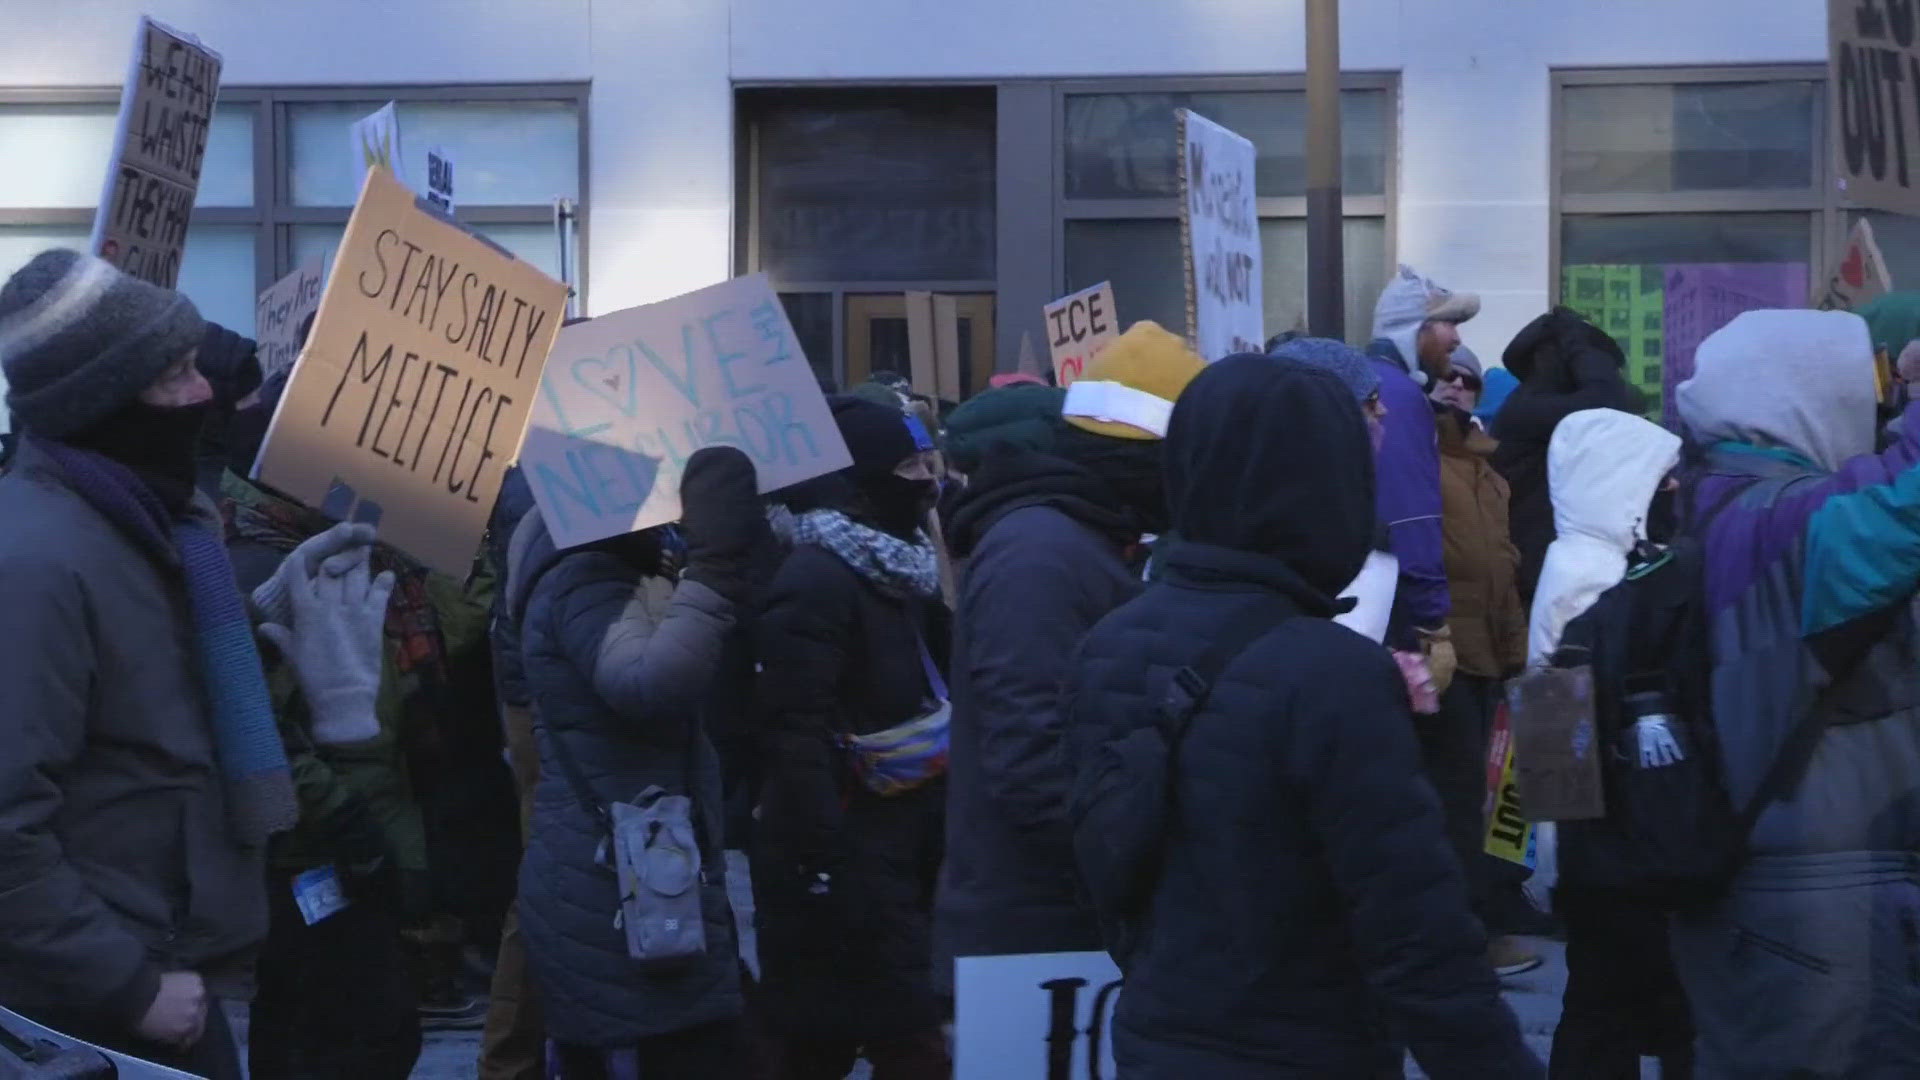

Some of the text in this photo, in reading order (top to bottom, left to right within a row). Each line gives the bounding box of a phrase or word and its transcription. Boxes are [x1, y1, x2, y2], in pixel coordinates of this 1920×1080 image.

[1840, 41, 1910, 189] OUT
[261, 272, 319, 336] They Are
[359, 229, 546, 379] STAY SALTY
[1049, 293, 1107, 348] ICE
[321, 330, 512, 503] MELT ICE
